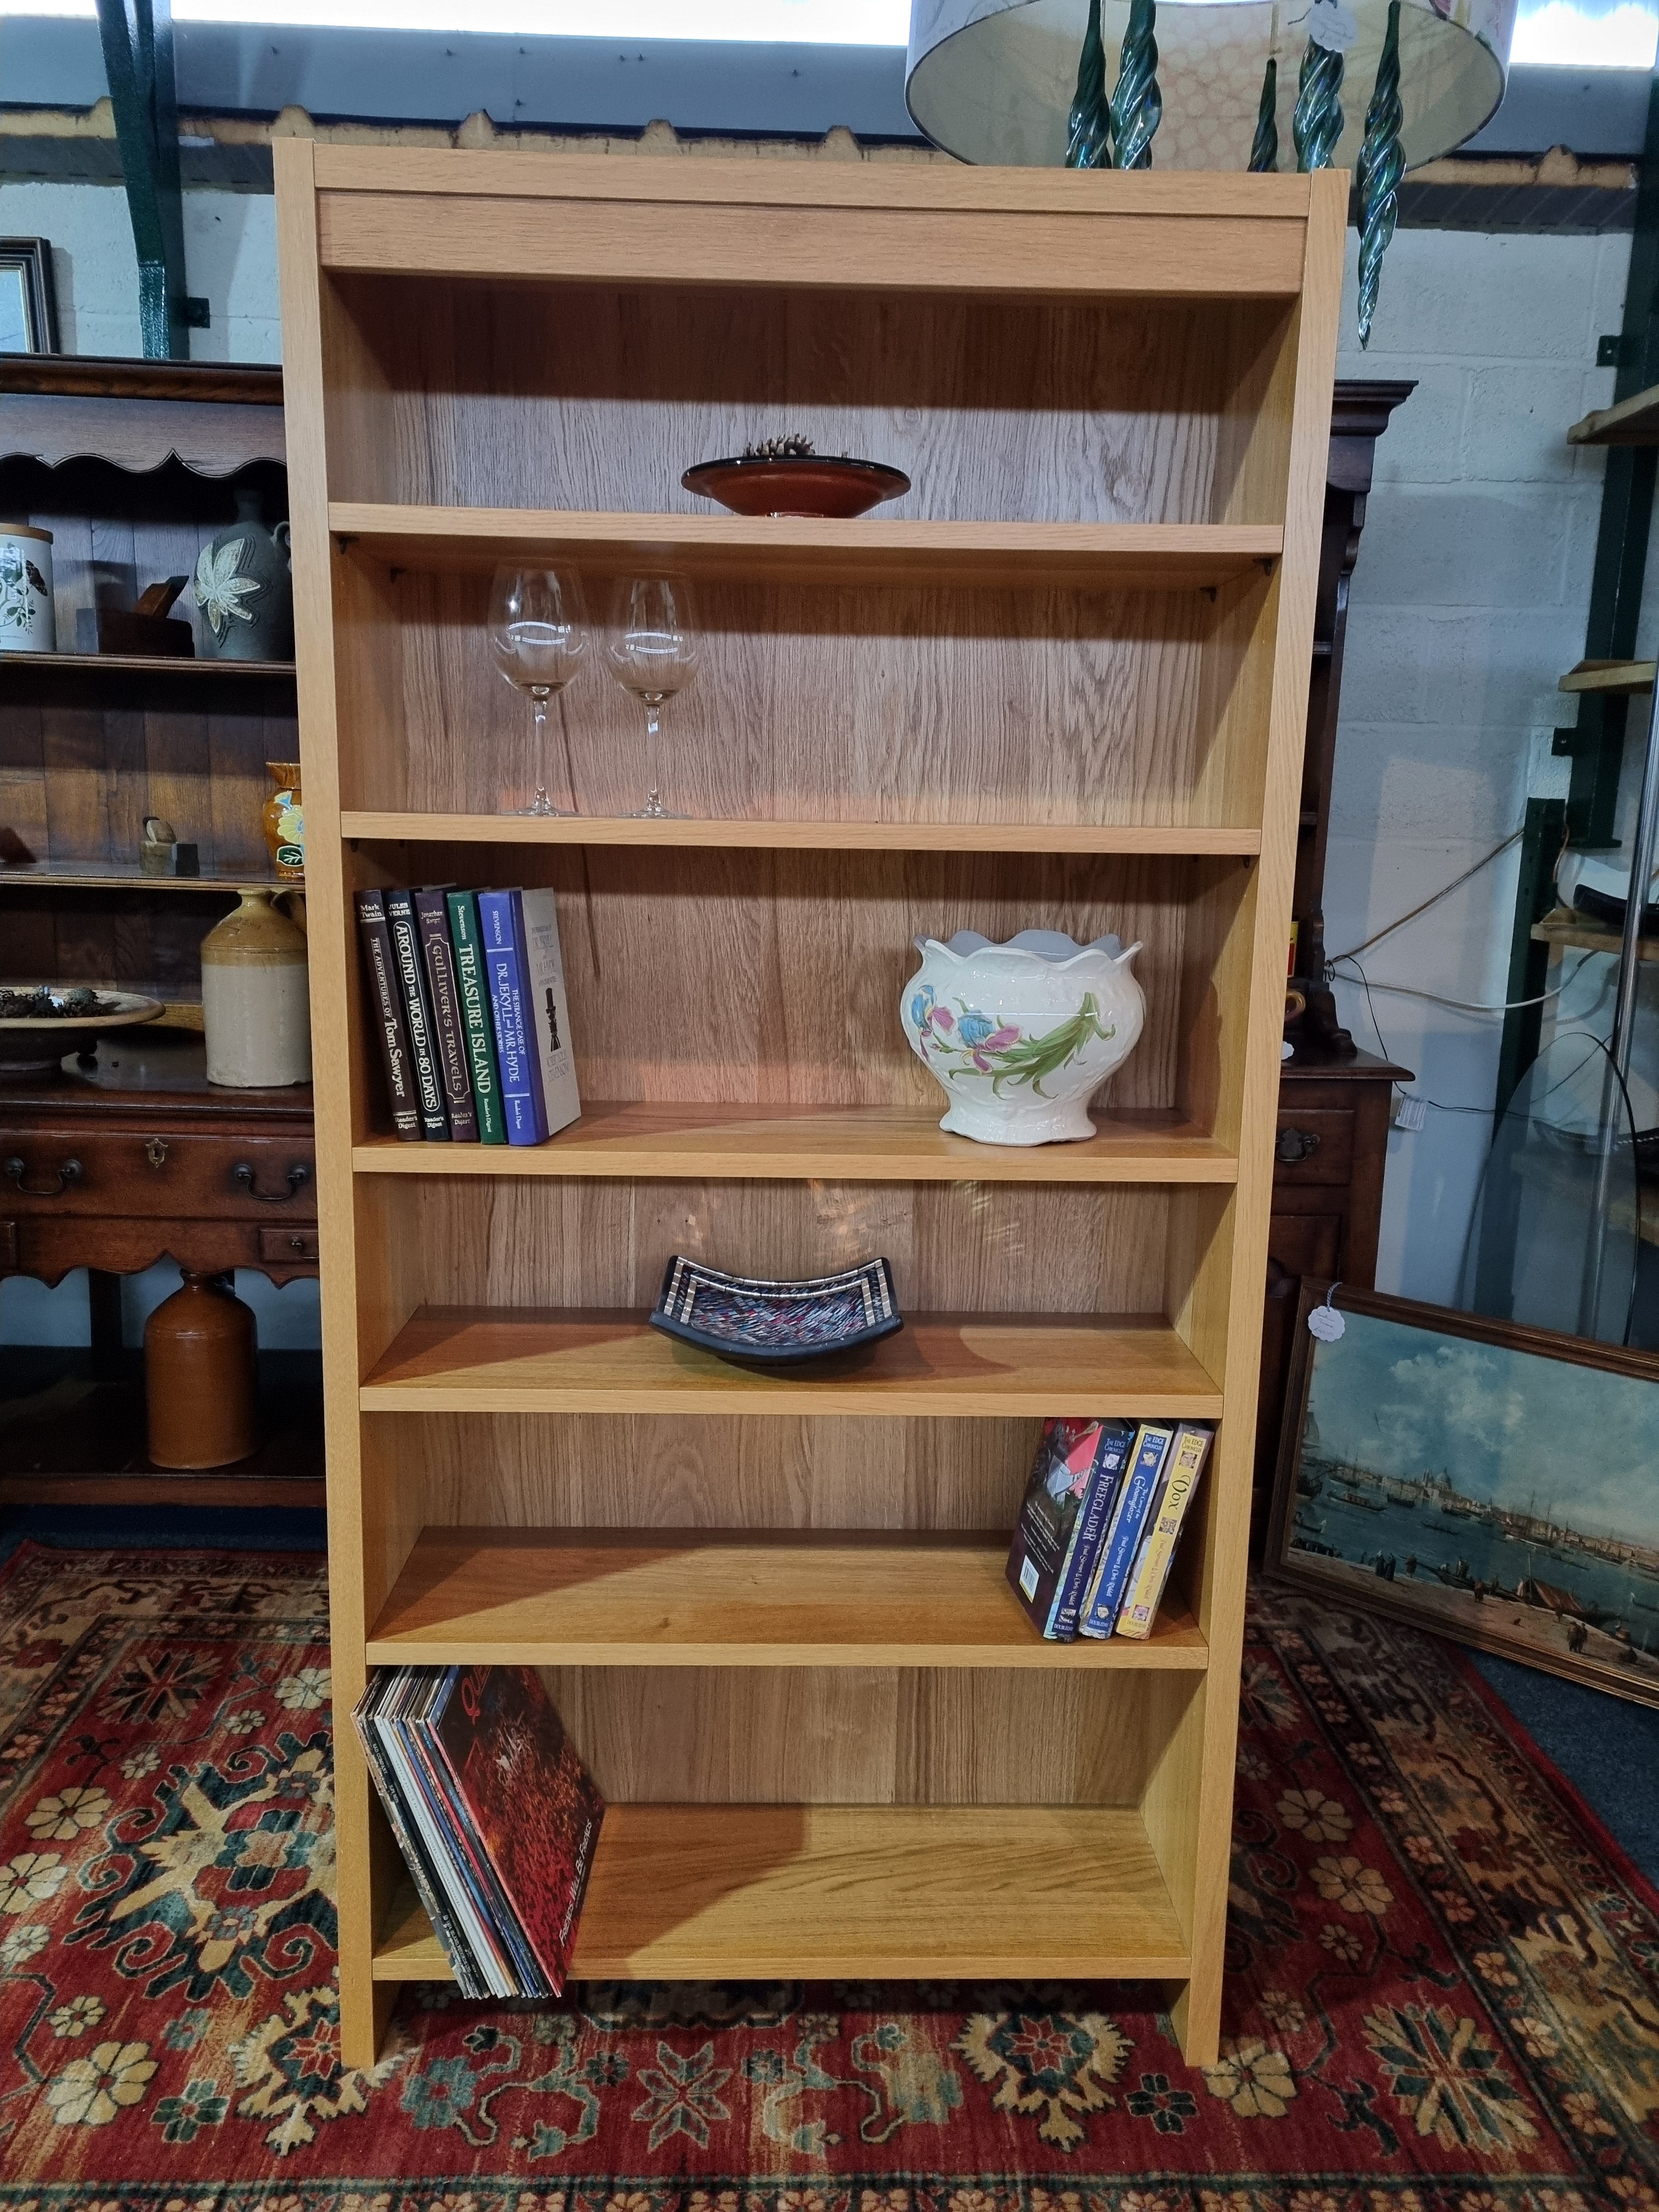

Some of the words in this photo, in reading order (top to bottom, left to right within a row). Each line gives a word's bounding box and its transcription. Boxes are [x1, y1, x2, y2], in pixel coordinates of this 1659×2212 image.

[458, 905, 467, 940] Stevenson
[493, 911, 502, 945] STEVENSON
[372, 938, 380, 954] THE
[396, 926, 416, 984] AROUND
[375, 956, 389, 1006] ADVENTURES
[498, 980, 513, 1022] JEKYLL
[385, 1018, 398, 1048] Tom
[409, 998, 426, 1047] WORLD
[459, 944, 483, 1029] TREASURE
[471, 1033, 491, 1093] ISLAND
[514, 1002, 522, 1030] STRANGE
[518, 1046, 525, 1055] OF
[504, 1030, 516, 1051] MR.
[390, 1048, 405, 1097] Sawyer
[419, 1057, 431, 1074] 80
[506, 1051, 520, 1083] HYDE
[422, 1076, 437, 1108] DAYS
[1114, 1440, 1126, 1448] EDGE
[1152, 1436, 1165, 1445] EDGE
[1192, 1438, 1204, 1447] EDGE
[1082, 1473, 1115, 1542] FREEGLADER
[1126, 1476, 1146, 1523] Gloamglozer
[1169, 1475, 1191, 1510] Vox
[377, 1753, 388, 1774] COMPANY
